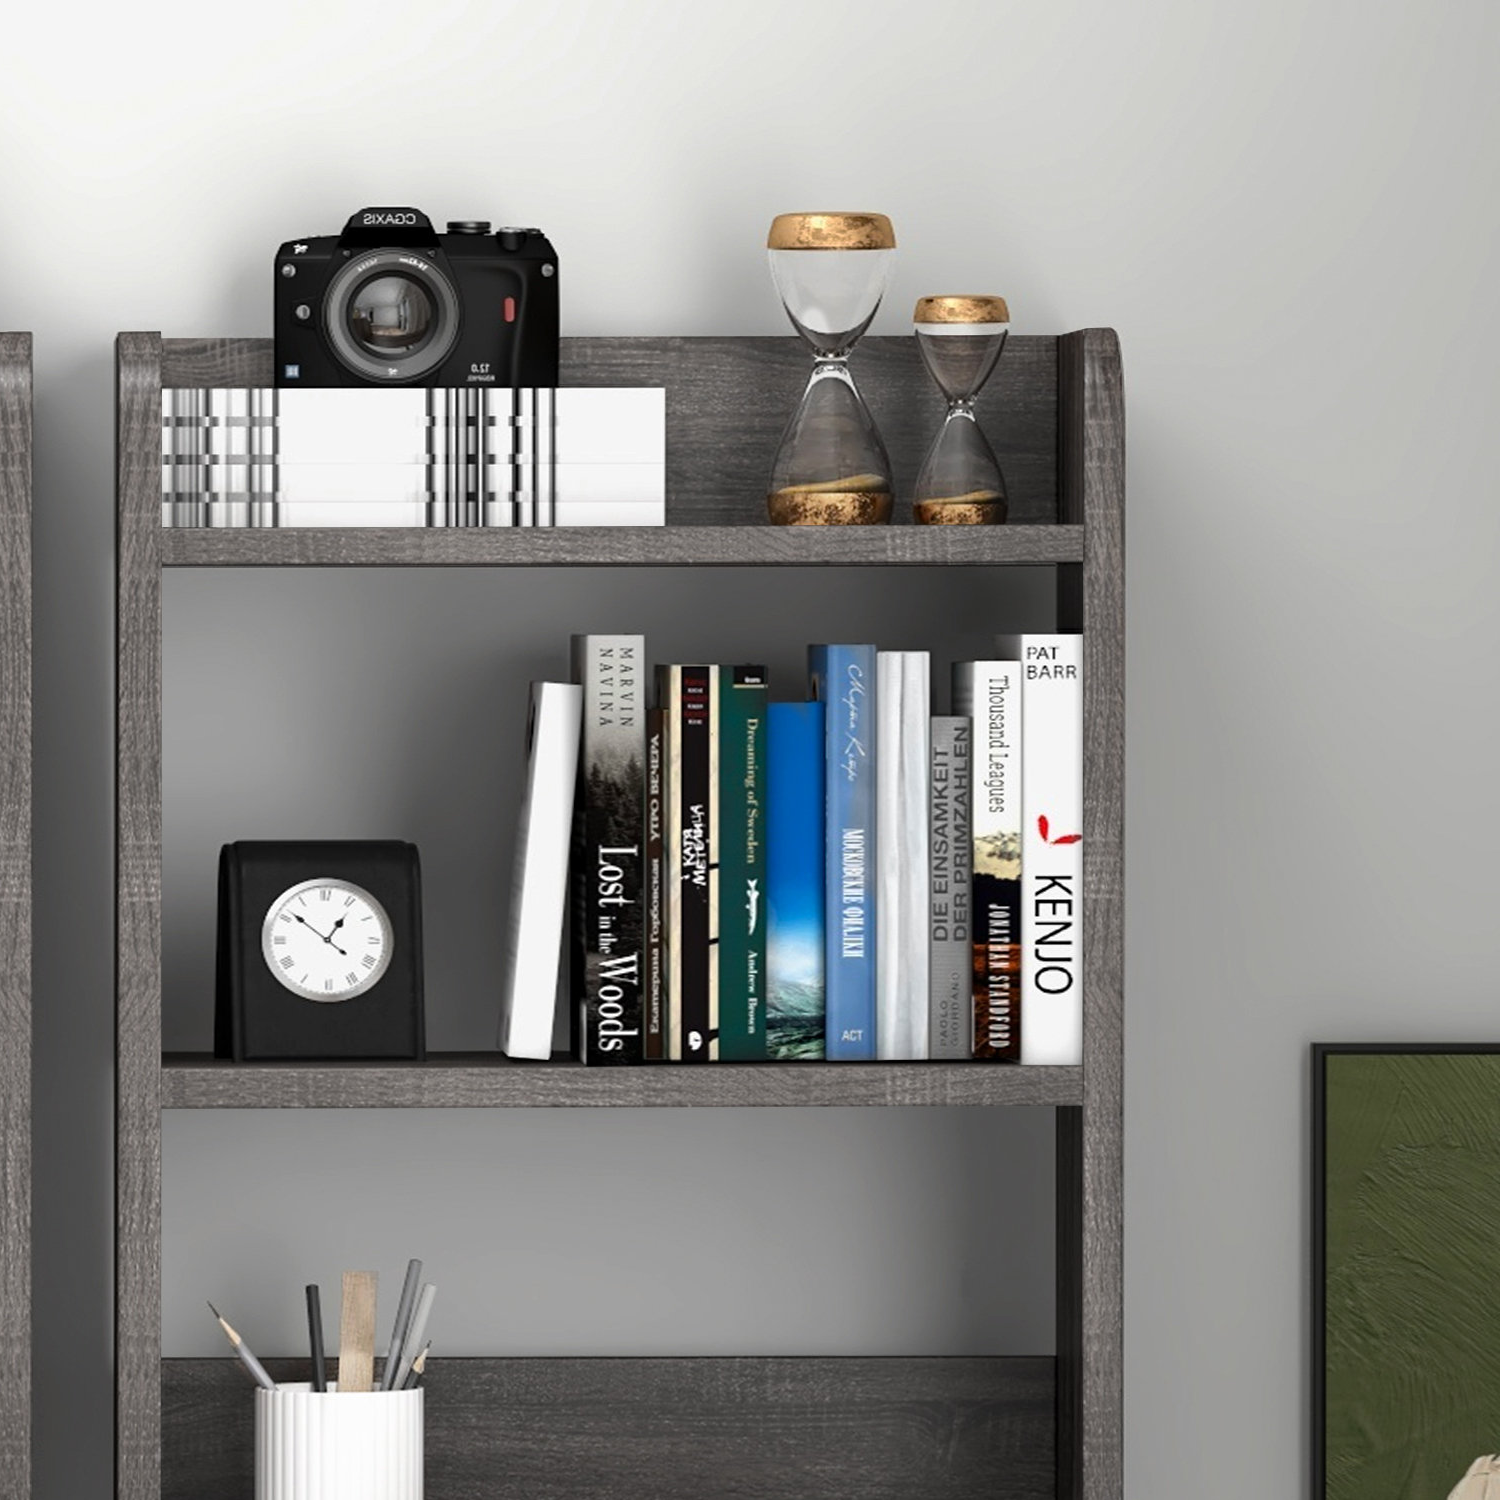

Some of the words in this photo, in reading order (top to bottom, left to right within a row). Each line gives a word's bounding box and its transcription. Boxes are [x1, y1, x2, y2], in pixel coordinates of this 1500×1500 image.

[1027, 646, 1060, 660] PAT
[1027, 664, 1077, 680] BARR
[599, 647, 614, 727] NAVINA
[619, 647, 634, 727] MARVIN
[989, 675, 1010, 750] Thousand
[650, 733, 660, 795] ВЕЧЕРА
[745, 718, 758, 788] Dreaming
[984, 752, 1009, 813] Leagues
[747, 791, 758, 806] of
[933, 746, 949, 895] EINSAMKEIT
[953, 725, 968, 885] PRIMZAHLEN
[747, 807, 758, 864] Sweden
[599, 845, 638, 908] Lost
[599, 916, 616, 930] in
[599, 933, 618, 954] the
[842, 905, 865, 958] ФИАЛКИ
[933, 901, 949, 942] DIE
[953, 897, 968, 942] DER
[988, 903, 1011, 969] JONATHAN
[1035, 875, 1073, 995] KENJO
[599, 951, 639, 1051] Woods
[747, 950, 758, 994] Andrew
[988, 974, 1011, 1048] STANDFORD
